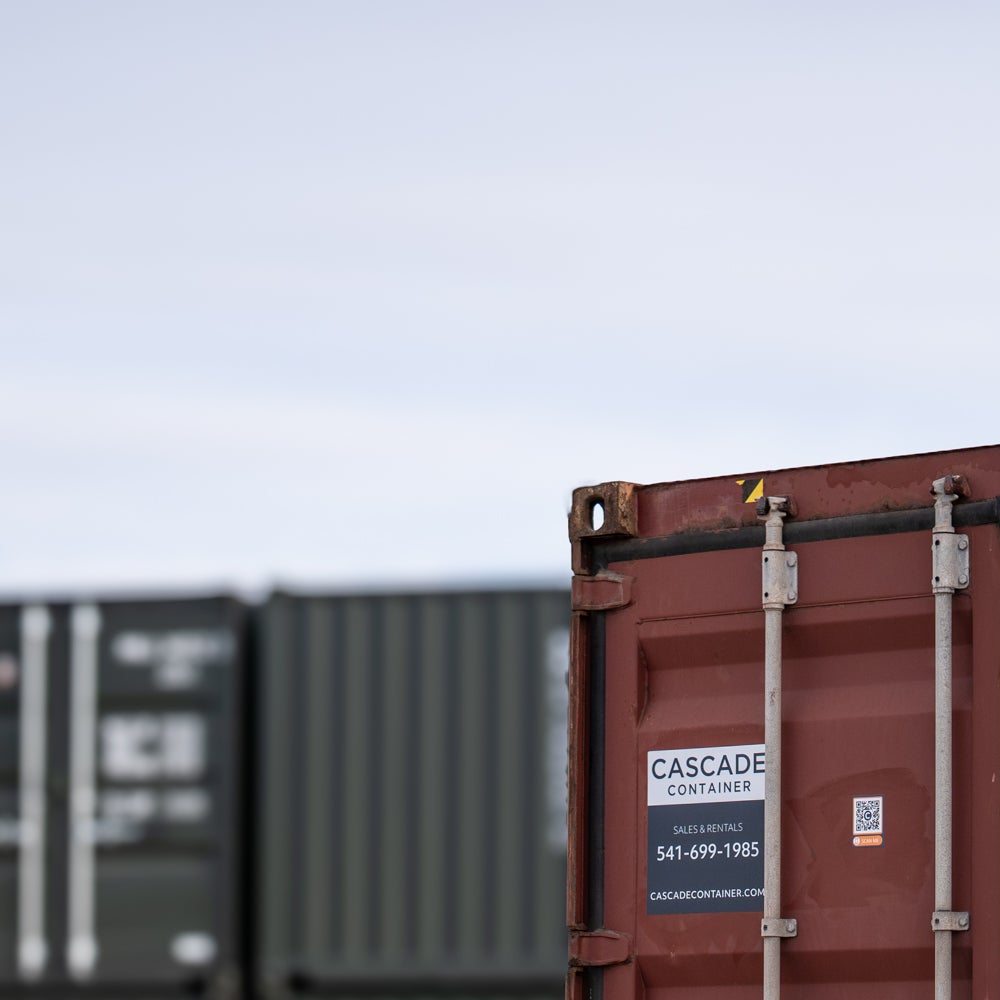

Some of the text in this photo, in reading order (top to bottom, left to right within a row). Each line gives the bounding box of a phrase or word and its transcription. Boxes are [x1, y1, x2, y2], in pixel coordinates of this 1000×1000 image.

[651, 752, 765, 779] CASCADE
[667, 780, 752, 796] CONTAINER
[673, 822, 744, 835] SALES & RENTALS
[656, 841, 760, 861] 541-699-1985
[650, 888, 765, 901] CASCADECONTAINER.COM
